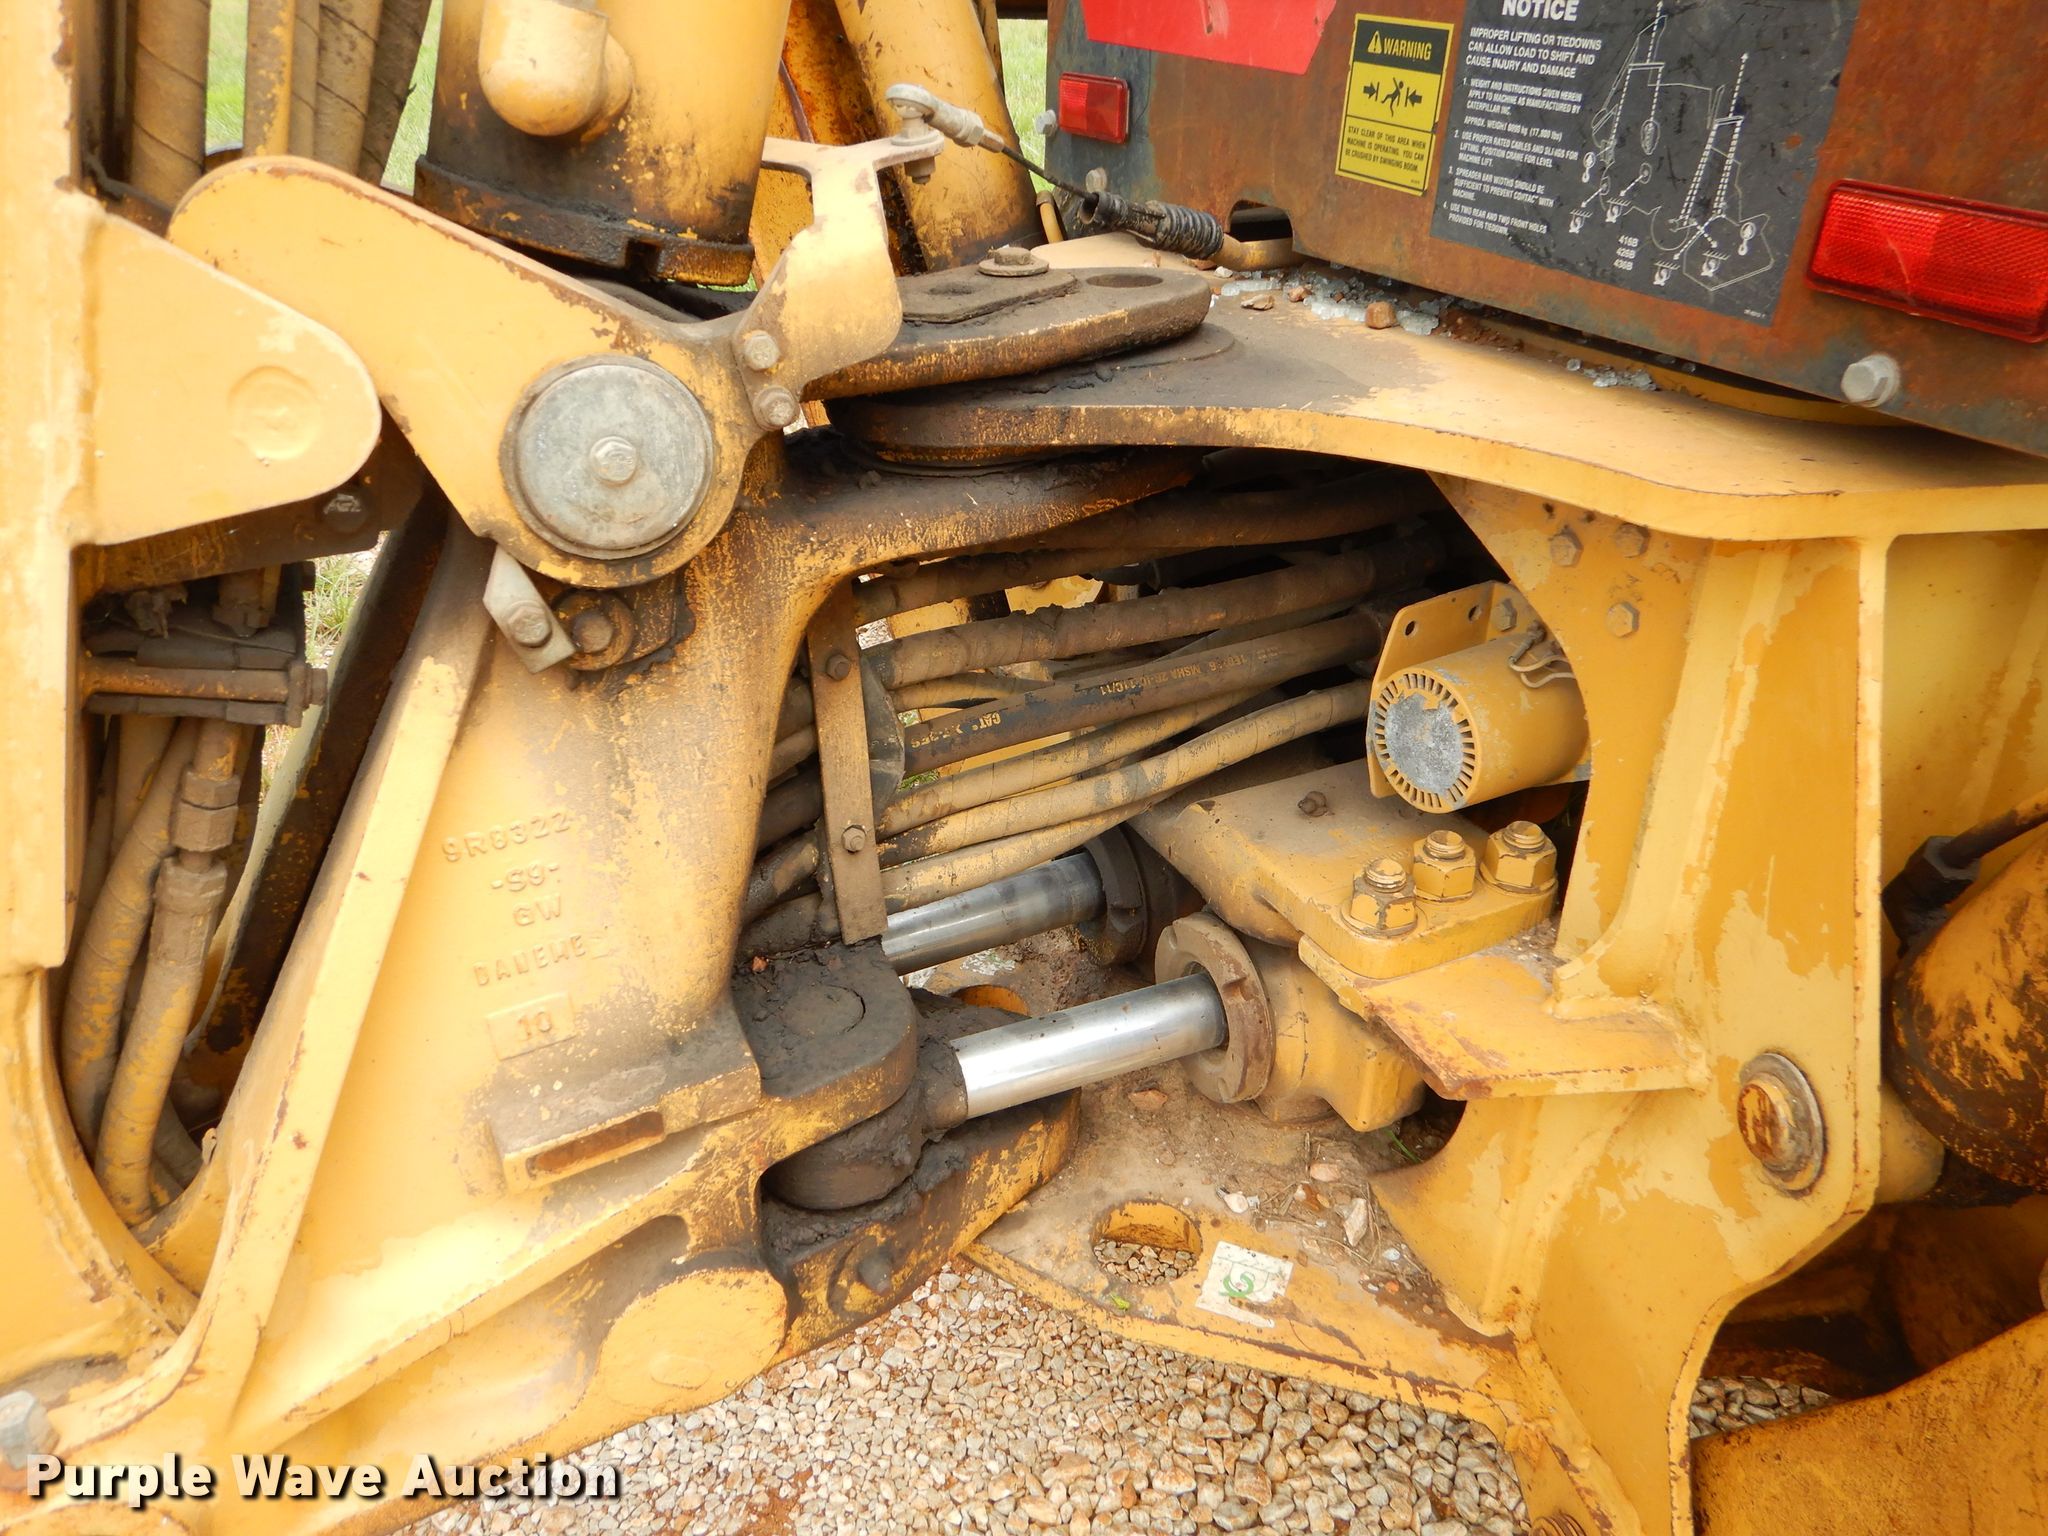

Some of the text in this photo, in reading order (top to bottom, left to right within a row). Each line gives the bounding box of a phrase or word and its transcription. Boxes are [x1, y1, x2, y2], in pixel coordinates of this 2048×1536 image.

[1502, 0, 1579, 21] NOTICE
[1384, 37, 1432, 61] WARNING
[1470, 27, 1602, 50] IMPROPER LIFTING OR TIEDOWNS
[1468, 41, 1595, 65] CAN ALLOW LOAD TO SHIFT AND
[1466, 55, 1577, 79] CAUSE INJURY AND DAMAGE
[1468, 90, 1581, 114] APPLY TO MACHINE AS MANUFACTURED BY
[1470, 79, 1491, 89] WEIGHT
[1491, 80, 1502, 90] AND
[1502, 82, 1542, 96] INSTRUCTIONS
[1542, 88, 1560, 98] GIVEN
[1560, 90, 1582, 102] HEREIN
[1467, 100, 1501, 112] CATERPILLAR
[1487, 120, 1507, 130] WEIGHT
[1347, 137, 1366, 148] MACHINE
[1413, 153, 1424, 161] CAN
[1348, 126, 1359, 134] STAY
[1360, 128, 1375, 137] CLEAR
[1385, 133, 1395, 143] THIS
[1397, 136, 1410, 145] AREA
[1412, 140, 1426, 149] WHEN
[1461, 131, 1472, 141] USE
[1472, 133, 1493, 144] PROPER
[1493, 137, 1511, 147] RATED
[1511, 140, 1532, 151] CABLES
[1532, 143, 1545, 154] AND
[1566, 150, 1579, 161] FOR
[1351, 150, 1372, 161] CRUSHED
[1379, 156, 1403, 169] SWINGING
[1458, 152, 1481, 164] MACHINE
[1481, 145, 1506, 158] POSITION
[1524, 153, 1537, 164] FOR
[1455, 167, 1482, 180] SPREADER
[1454, 177, 1482, 190] SUFFICIENT
[1490, 185, 1514, 198] PREVENT
[1448, 213, 1473, 226] PROVIDED
[1473, 218, 1484, 229] FOR
[1450, 202, 1460, 212] USE
[1460, 205, 1472, 215] TWO
[1472, 208, 1487, 219] REAR
[1486, 211, 1498, 221] AND
[1510, 217, 1529, 229] FRONT
[517, 1008, 553, 1041] 10
